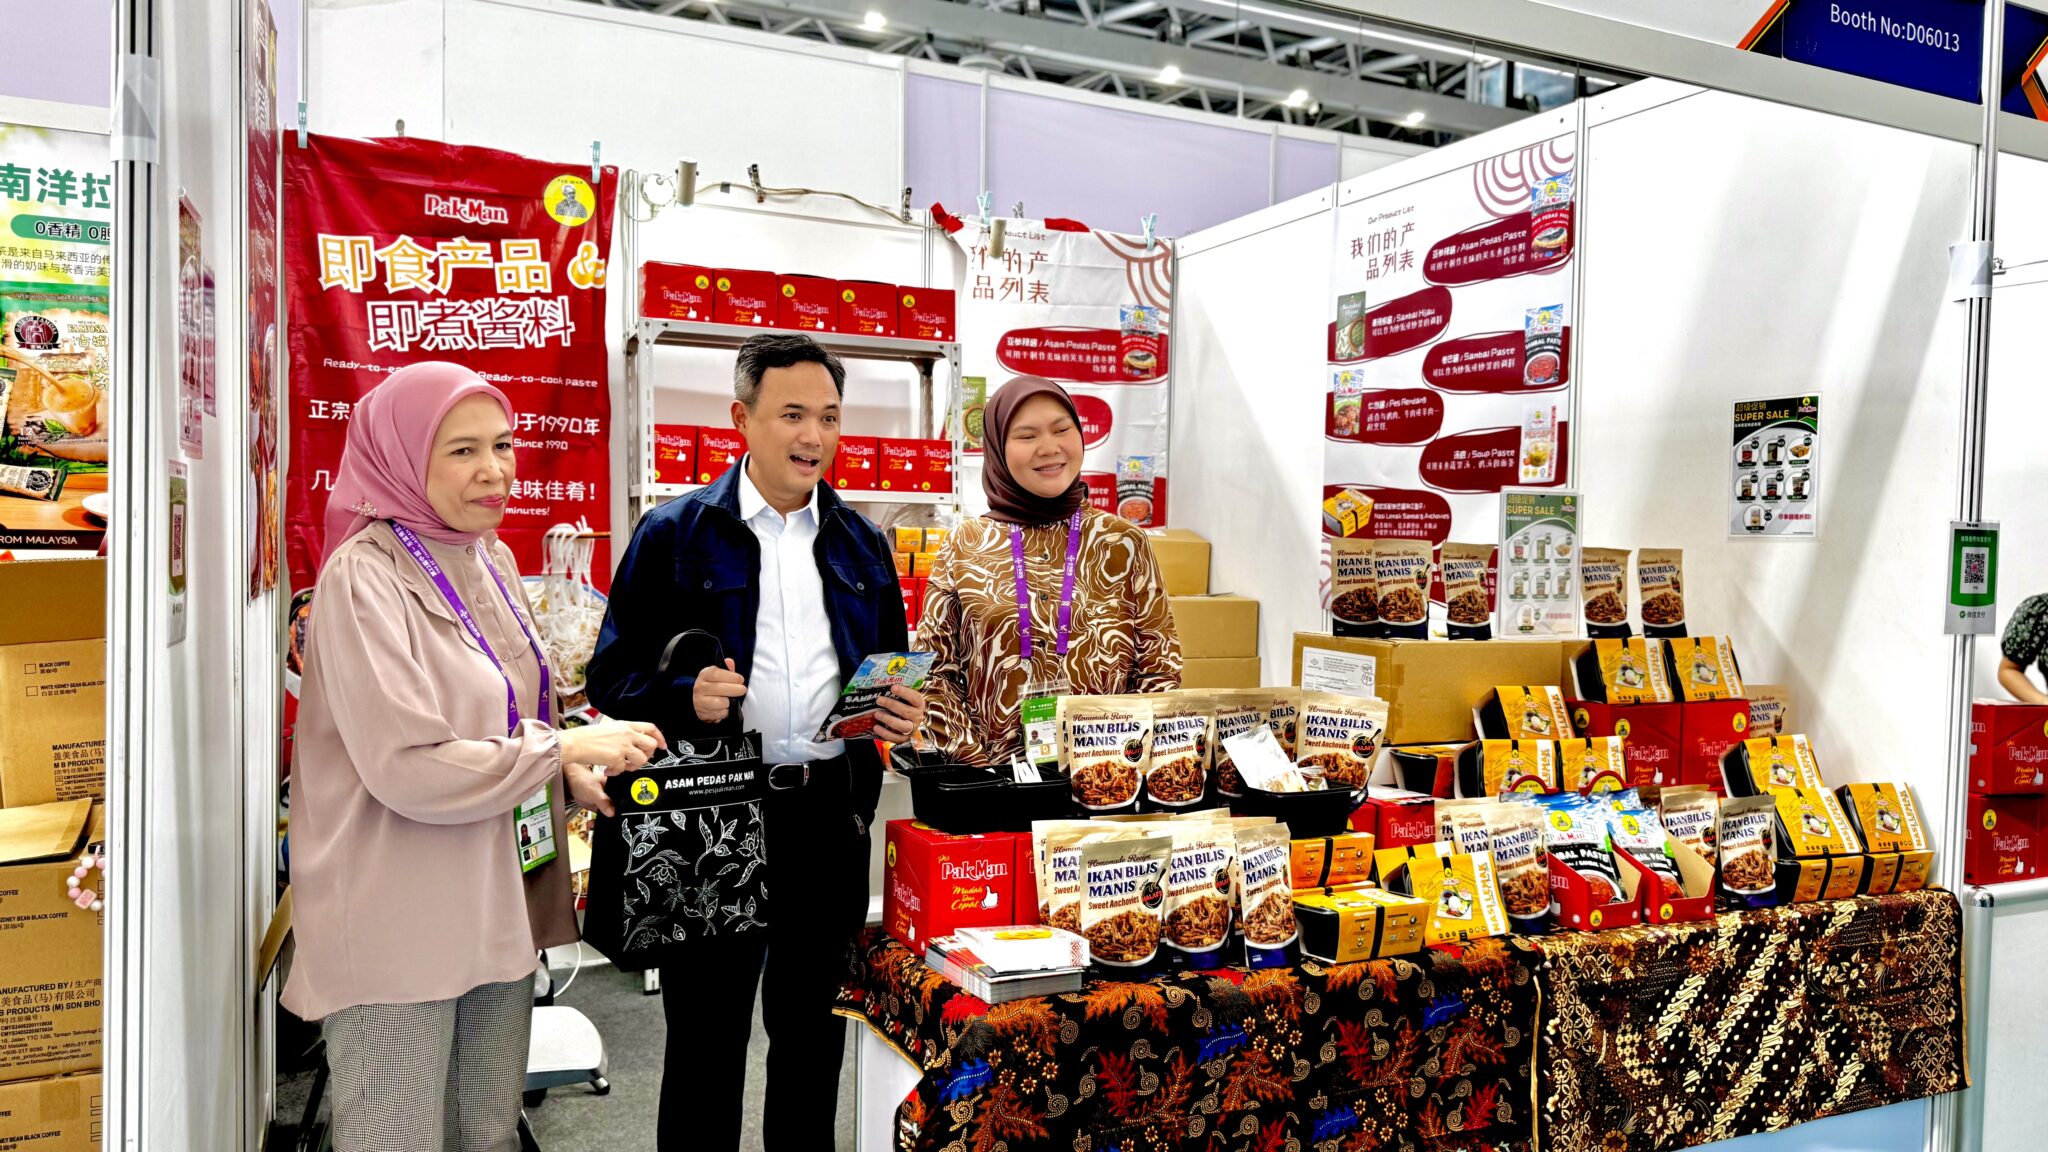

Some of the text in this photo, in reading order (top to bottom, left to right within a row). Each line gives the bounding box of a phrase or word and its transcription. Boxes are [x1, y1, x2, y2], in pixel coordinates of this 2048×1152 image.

[1830, 4, 1960, 52] Booth No:D06013
[425, 193, 509, 225] PakMan
[1368, 205, 1415, 225] Our Product List
[35, 221, 81, 239] 0香精
[1028, 232, 1047, 240] List
[1351, 221, 1416, 260] 我们的产
[1461, 242, 1479, 252] Asam
[1480, 235, 1501, 246] Pedas
[1502, 229, 1527, 241] Paste
[1, 259, 110, 277] 滑的奶味与茶香完美
[318, 233, 606, 295] 即食产品 &
[1366, 249, 1414, 282] 品列表
[973, 274, 1049, 304] 品列表
[1396, 308, 1435, 322] Sambal Hijau
[67, 323, 108, 334] FAMOSA
[367, 296, 576, 352] 即煮酱料
[1044, 339, 1065, 348] Asam
[1066, 340, 1090, 350] Pedas
[1091, 342, 1117, 351] Paste
[1463, 347, 1516, 360] Sambal Paste
[565, 378, 598, 388] paste
[309, 399, 358, 420] 正宗
[1734, 409, 1790, 422] SUPER SALE
[20, 427, 33, 436] 12
[513, 438, 569, 451] Since 1990
[1471, 448, 1515, 458] Soup Paste
[311, 470, 334, 491] 几
[505, 506, 550, 516] minutes!
[1506, 505, 1555, 515] SUPER SALE
[26, 536, 78, 544] MALAYSIA
[1374, 557, 1425, 569] IKAN BILIS
[1337, 567, 1371, 577] MANIS
[1377, 567, 1411, 578] MANIS
[1072, 712, 1134, 722] Homemade Recipe
[1270, 706, 1296, 719] BILIS
[1308, 705, 1367, 718] Homemade Recipe
[1072, 721, 1140, 736] IKAN BILIS
[1153, 717, 1205, 734] KAN BILIS
[1306, 715, 1373, 730] IKAN BILIS
[1305, 726, 1348, 740] MANIS
[1073, 735, 1117, 748] MANIS
[1322, 740, 1350, 750] Anchovies
[1073, 748, 1122, 759] Sweet Anchovies
[1627, 743, 1669, 762] PakMan
[68, 758, 104, 767] PRODUCTS
[664, 777, 694, 790] ASAM
[697, 774, 727, 787] PEDAS
[728, 773, 743, 783] PAK
[1722, 817, 1744, 831] IKAN
[1460, 829, 1488, 843] IKAN
[1493, 836, 1520, 849] IKAN
[1195, 840, 1217, 850] Recipe
[1196, 850, 1226, 864] BILIS
[1496, 844, 1530, 862] MANIS
[1582, 850, 1609, 861] PASTE
[1087, 854, 1152, 868] Homemade Recipe
[1243, 854, 1266, 872] IKAN
[941, 859, 1008, 882] PakMan
[1087, 862, 1158, 883] IKAN BILIS
[1168, 867, 1207, 885] MANIS
[1245, 863, 1277, 885] MANIS
[952, 885, 983, 895] Mudah
[1053, 886, 1073, 895] Sweet
[1088, 880, 1136, 898] MANIS
[1167, 887, 1186, 898] Sweet
[1186, 881, 1213, 894] Anchovies
[951, 899, 980, 911] Cepat
[1088, 900, 1110, 910] Sweet
[1109, 895, 1140, 907] Anchovies
[6, 999, 100, 1015] PRODUCTS (M) SDN BHD
